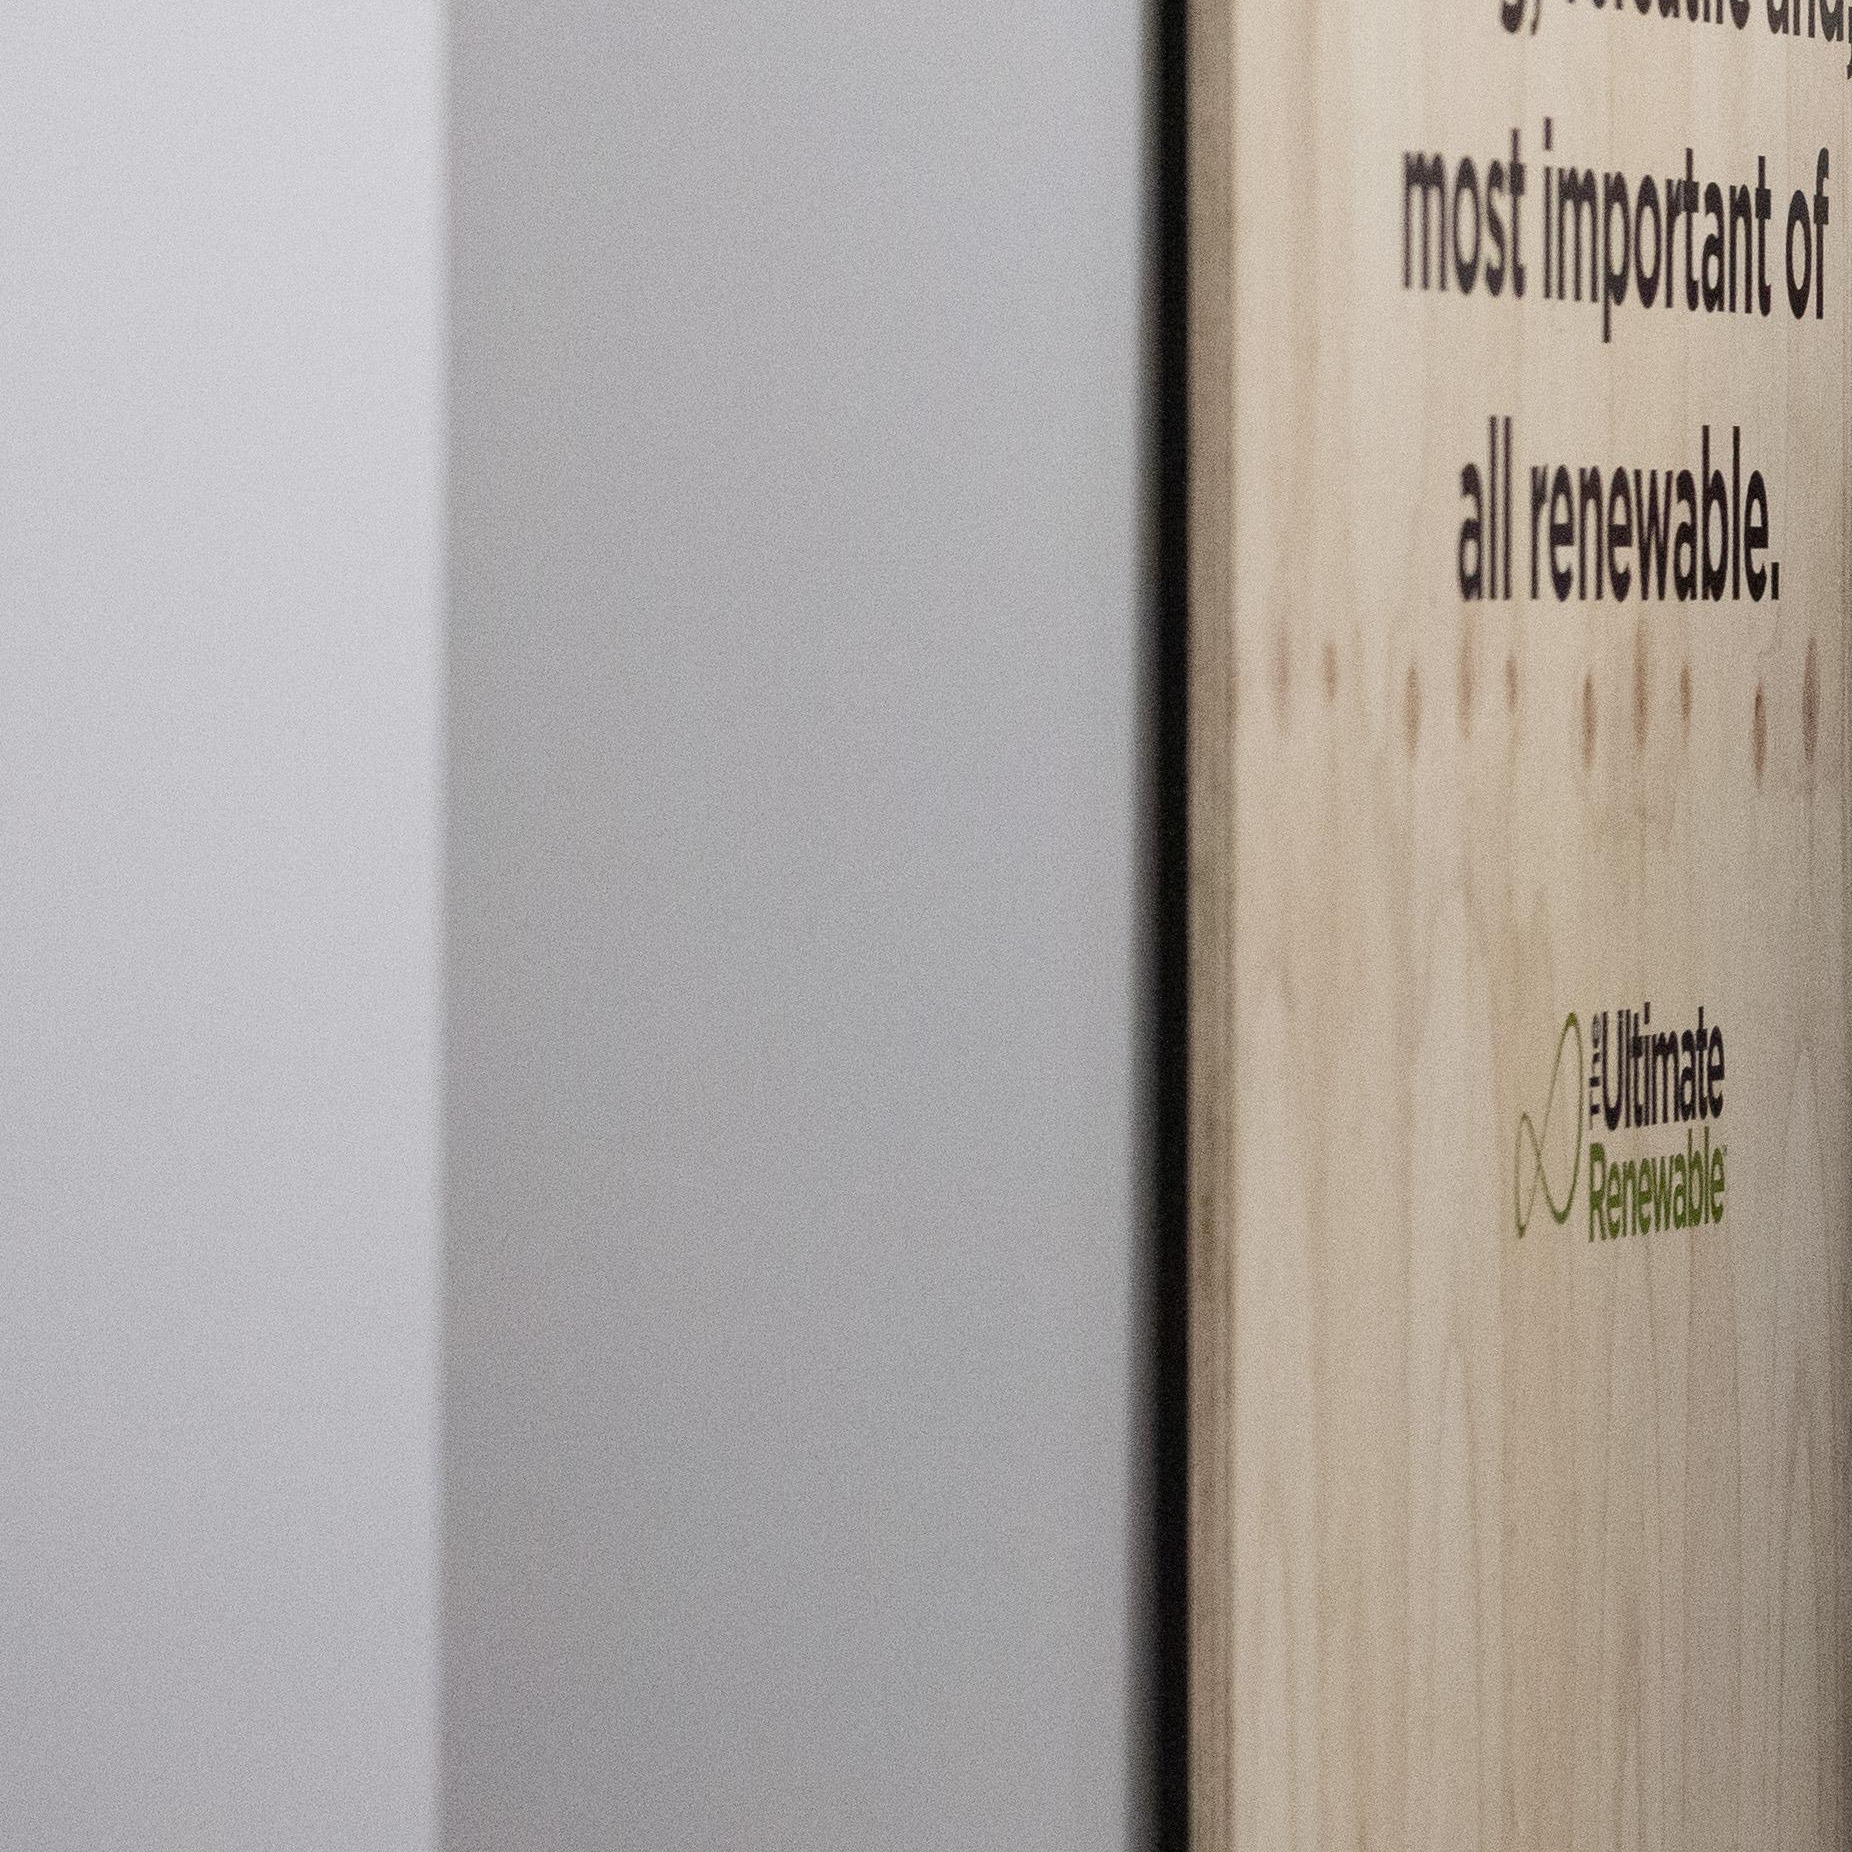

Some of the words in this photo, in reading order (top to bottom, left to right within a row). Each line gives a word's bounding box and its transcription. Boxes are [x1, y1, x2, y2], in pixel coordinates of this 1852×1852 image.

[1402, 127, 1527, 299] most
[1543, 116, 1772, 344] important
[1786, 147, 1830, 321] of
[1457, 415, 1513, 602] all
[1530, 424, 1781, 603] renewable.
[1602, 1001, 1725, 1132] Ultimate
[1588, 1125, 1725, 1243] Renewable
